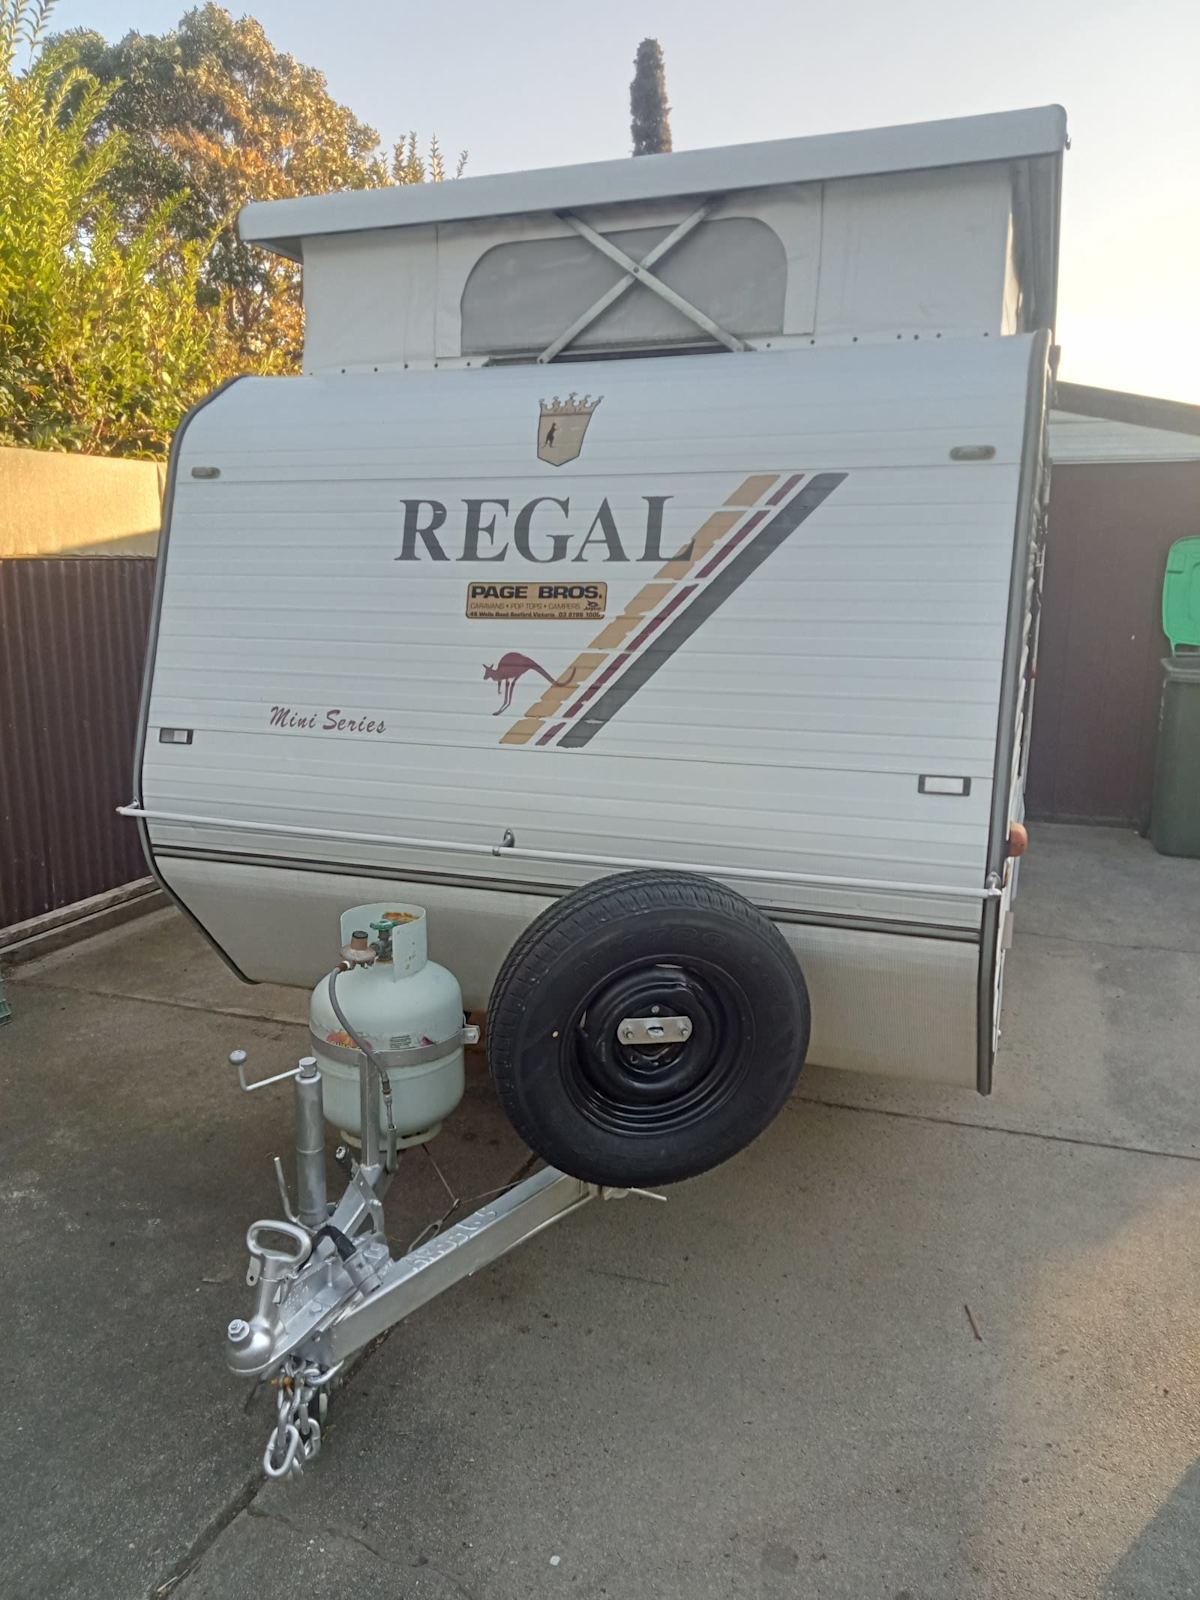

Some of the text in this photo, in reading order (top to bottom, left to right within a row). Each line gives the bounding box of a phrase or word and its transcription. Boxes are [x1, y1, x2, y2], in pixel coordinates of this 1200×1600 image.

[393, 495, 695, 563] REGAL
[471, 585, 603, 599] PAGE BROS.
[270, 706, 386, 734] Mini Series
